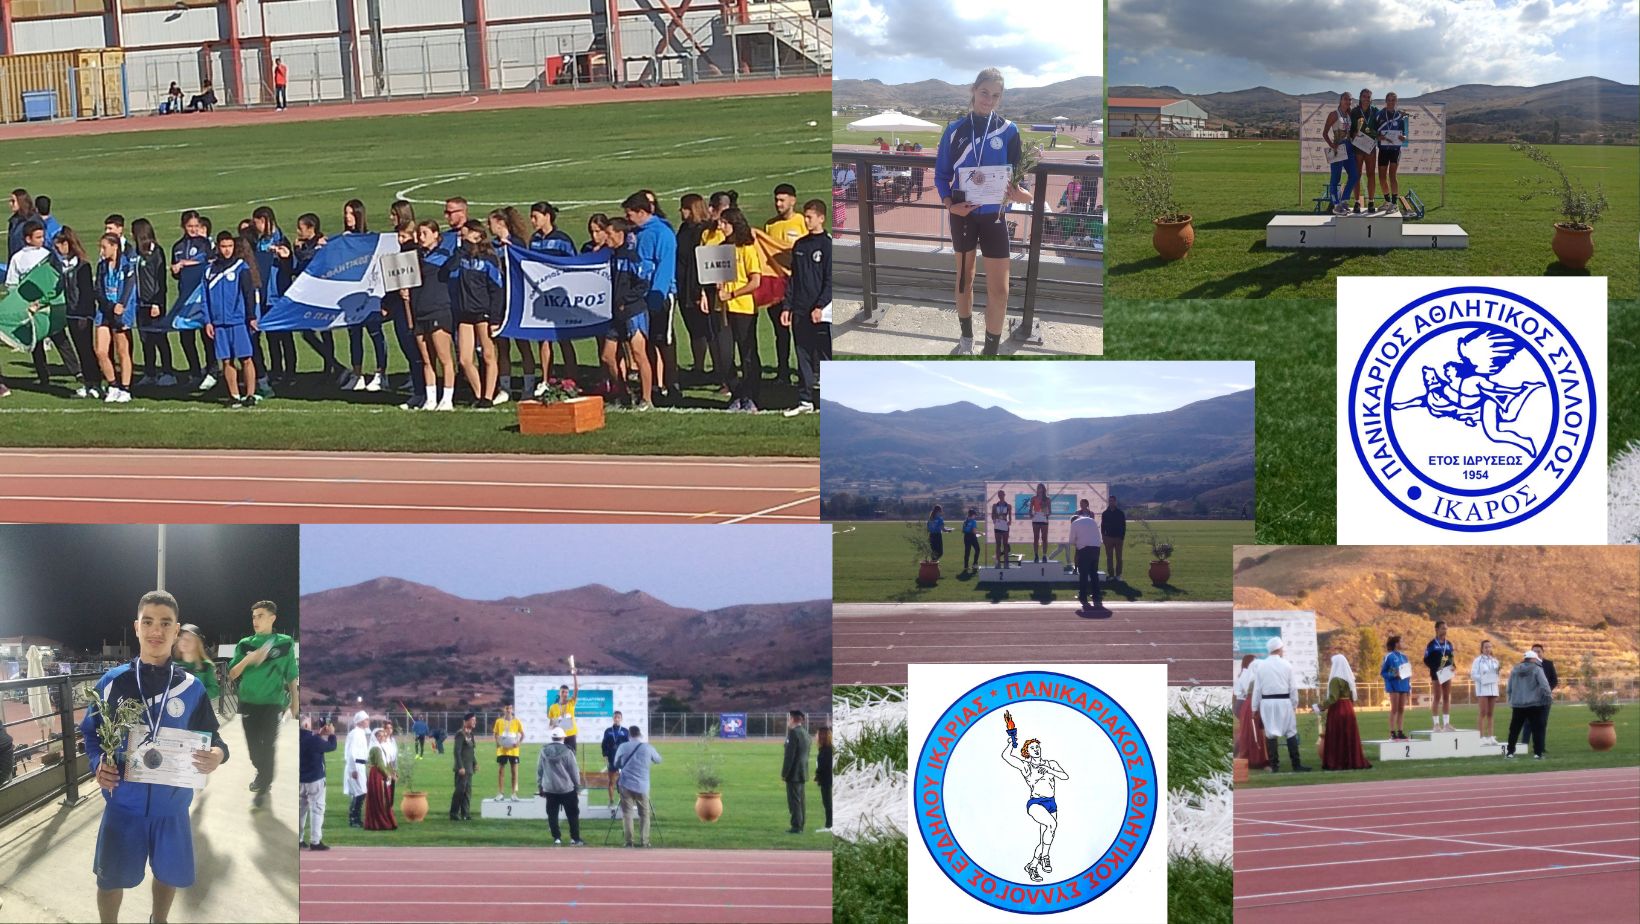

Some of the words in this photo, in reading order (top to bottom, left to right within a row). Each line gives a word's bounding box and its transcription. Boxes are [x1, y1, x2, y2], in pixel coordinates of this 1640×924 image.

[1299, 230, 1306, 244] 2
[1367, 224, 1372, 238] 1
[1431, 235, 1438, 249] 3
[544, 292, 606, 308] ΙΚΑΡΟΣ
[1405, 745, 1410, 758] 2
[1454, 738, 1458, 751] 1
[507, 805, 512, 816] 2
